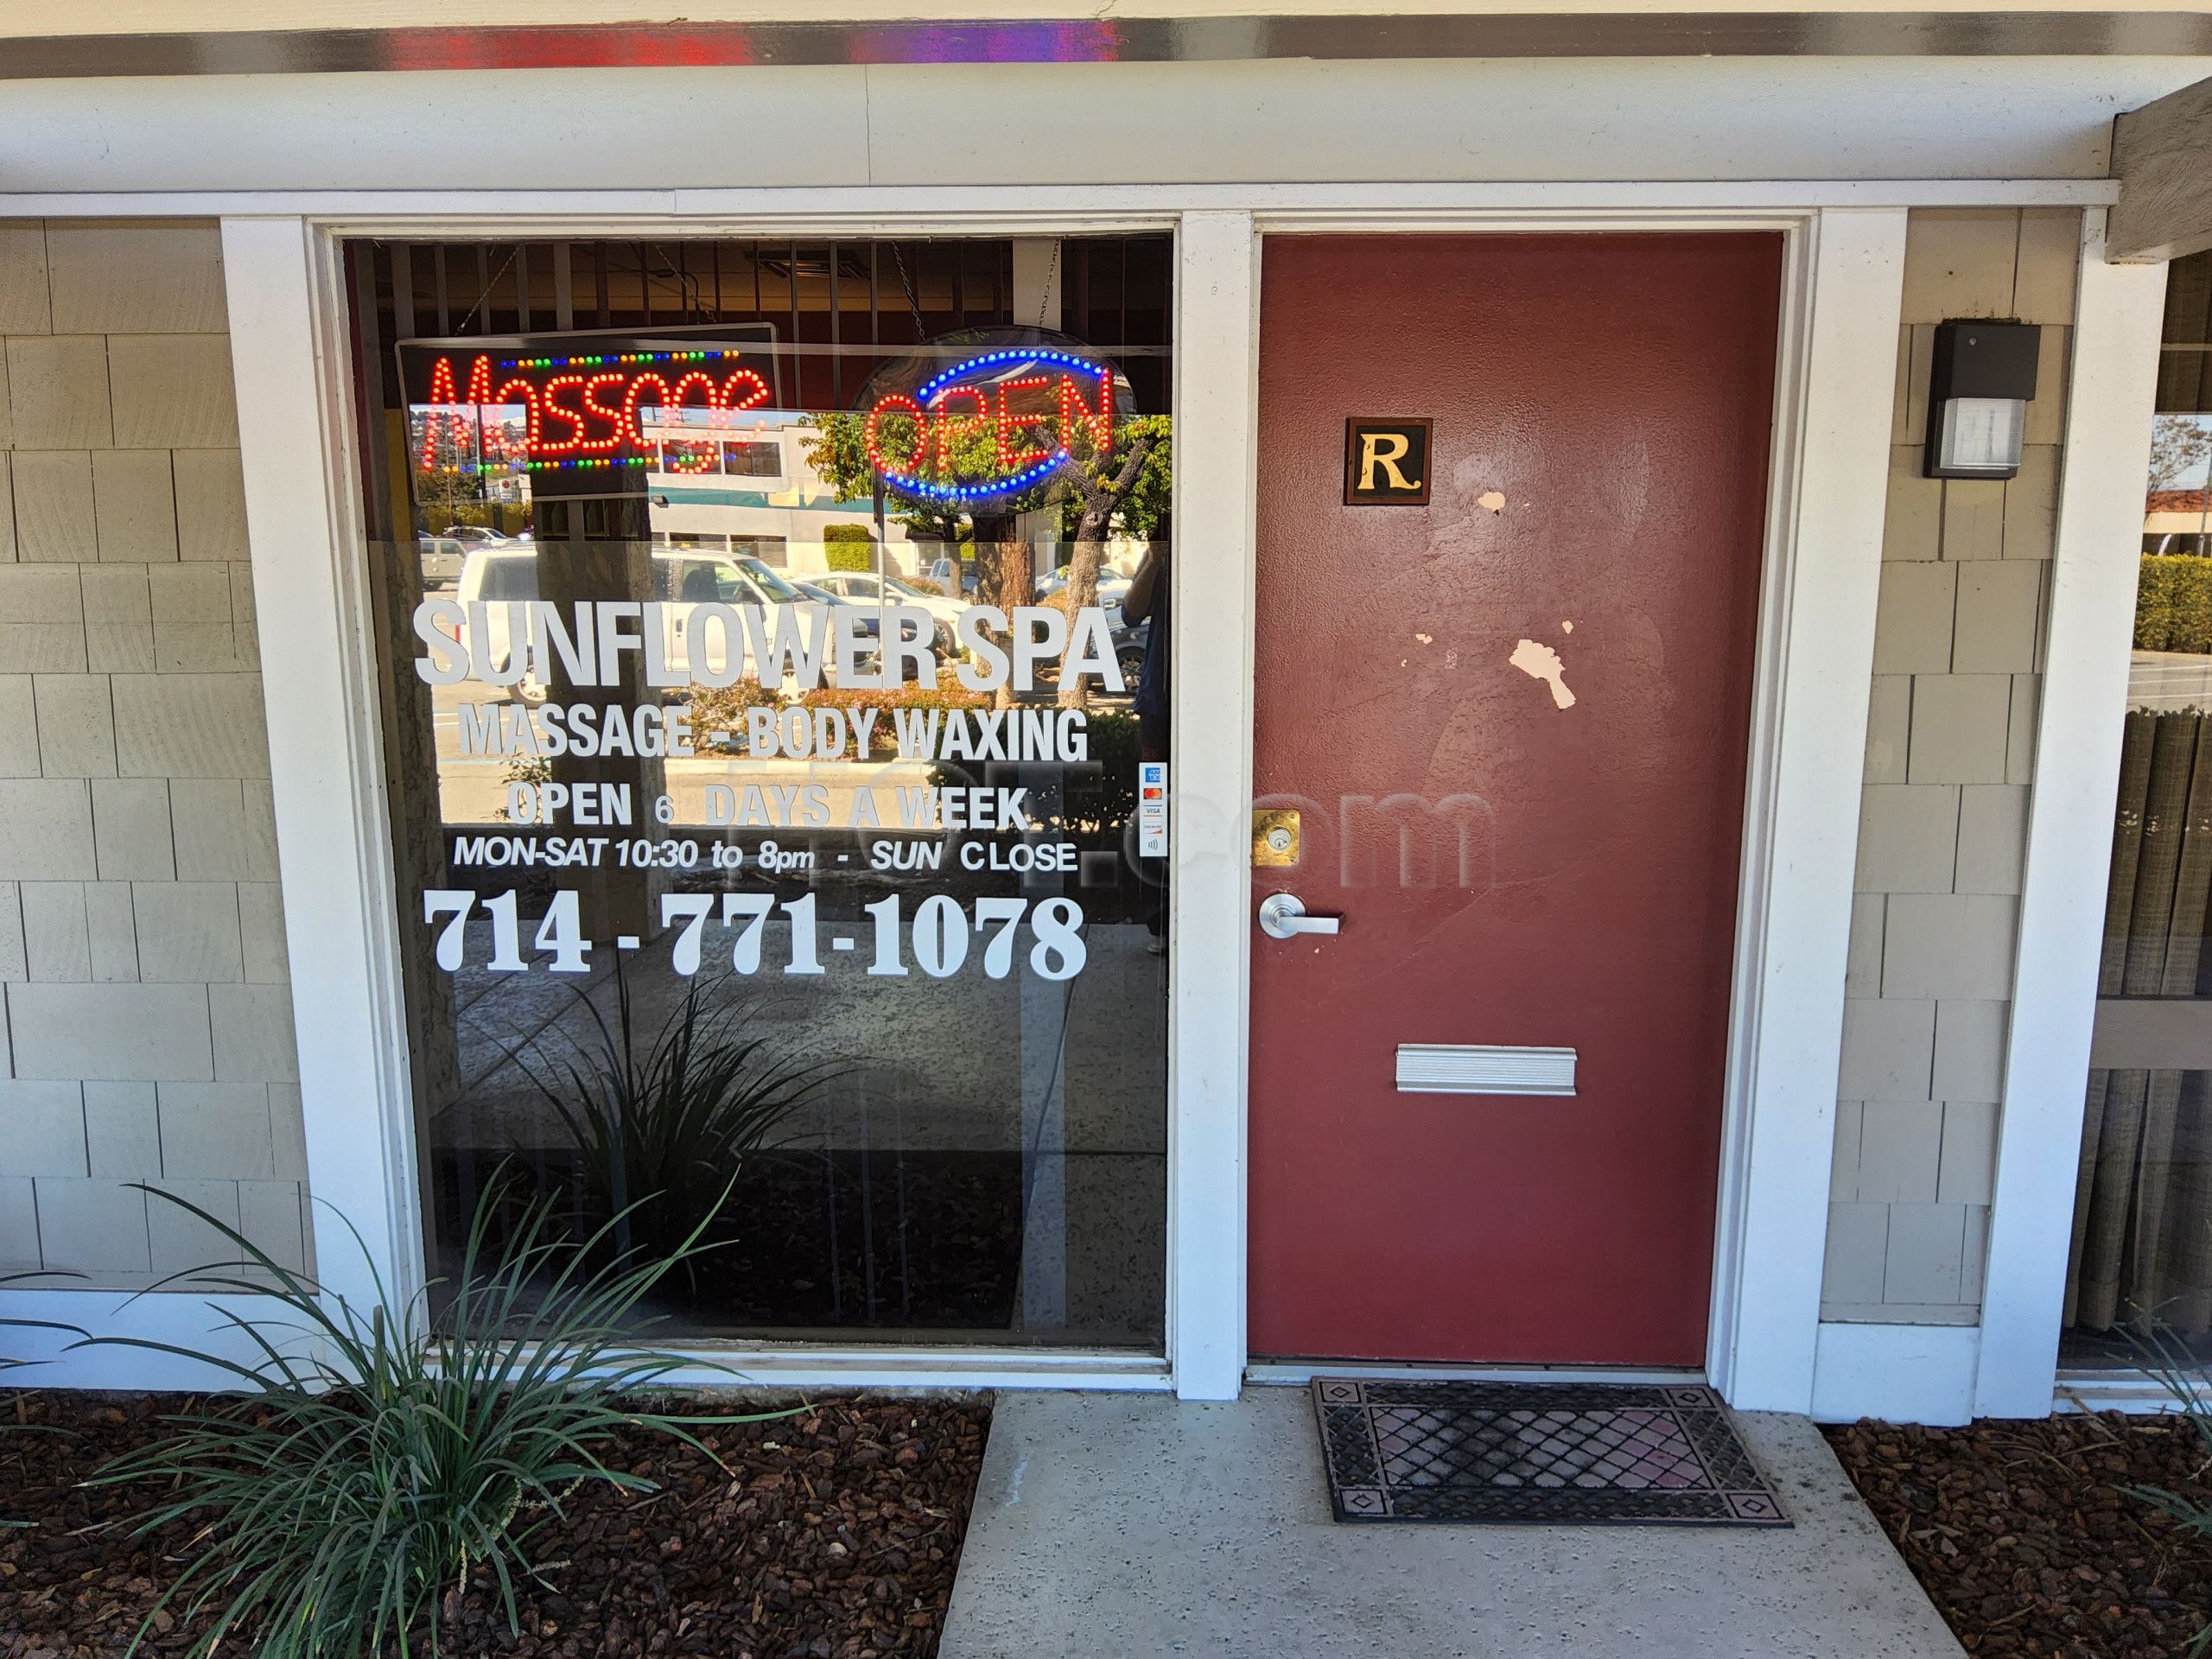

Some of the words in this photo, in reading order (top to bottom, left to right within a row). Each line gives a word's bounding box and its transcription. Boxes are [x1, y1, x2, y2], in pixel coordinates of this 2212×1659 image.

[865, 366, 1112, 474] OPEN
[1357, 434, 1421, 490] R
[413, 599, 938, 691] SUNFLOWER
[957, 604, 1126, 692] SPA
[458, 703, 695, 758] MASSAGE
[711, 731, 730, 742] -
[747, 706, 879, 760] BODY
[893, 709, 1088, 762] WAXING
[507, 783, 632, 826] OPEN
[655, 795, 674, 824] 6
[706, 784, 830, 827] DAYS
[848, 786, 880, 828] A
[895, 786, 1029, 830] WEEK
[454, 836, 610, 867] MON-SAT
[614, 840, 698, 868] 10:30
[711, 839, 743, 868] to
[758, 840, 815, 873] 8pm
[871, 841, 943, 870] SUN
[960, 841, 1078, 872] CLOSE
[423, 889, 593, 973] 714
